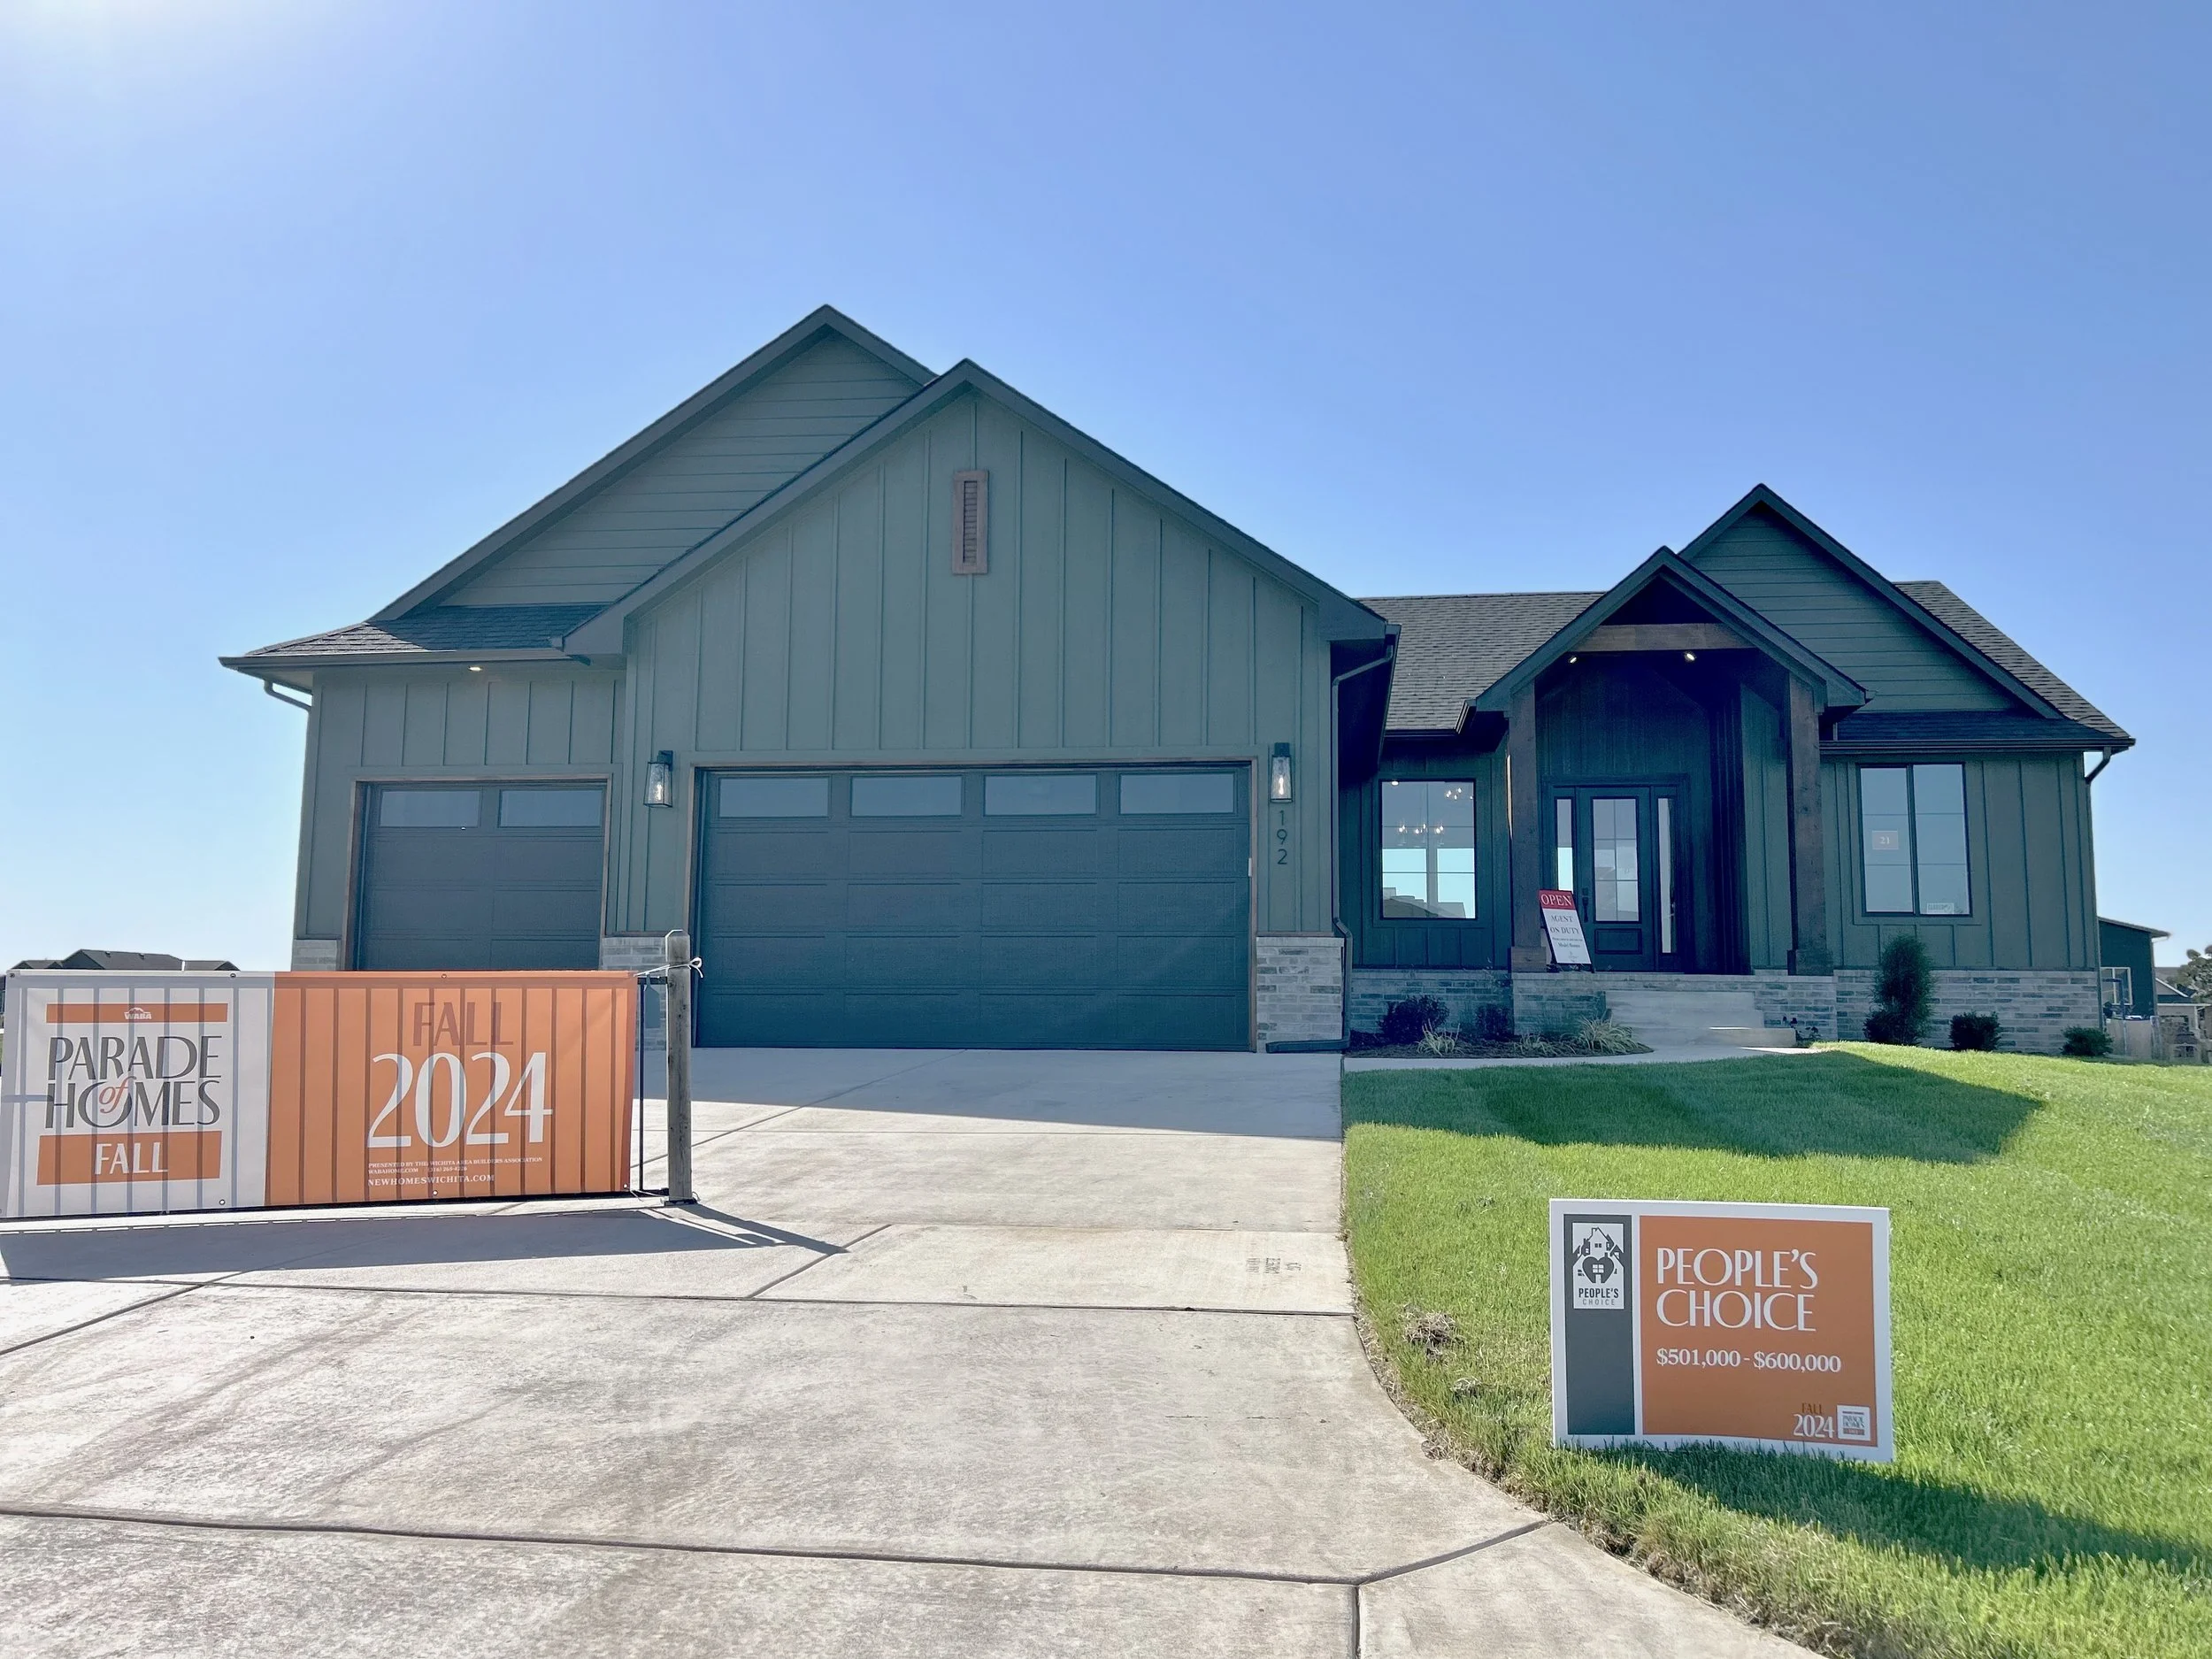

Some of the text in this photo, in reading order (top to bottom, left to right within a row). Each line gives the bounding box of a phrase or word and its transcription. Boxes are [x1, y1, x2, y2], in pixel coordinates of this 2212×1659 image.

[1277, 810, 1287, 864] 192
[1540, 894, 1572, 906] OPEN
[413, 1002, 513, 1046] FALL
[48, 1035, 222, 1080] PARADE
[45, 1079, 220, 1128] HOMES
[98, 1075, 136, 1113] of
[367, 1051, 553, 1148] 2024
[95, 1141, 168, 1174] FALL
[368, 1174, 495, 1187] NEWHOMESWICHITA.COM
[1656, 1248, 1818, 1289] PEOPLE'S
[1578, 1287, 1619, 1298] PEOPLE'S
[1655, 1288, 1816, 1332] CHOICE
[1656, 1348, 1741, 1368] $501,000
[1753, 1351, 1841, 1372] $600,000
[1793, 1413, 1835, 1439] 2024
[1801, 1402, 1823, 1415] FALL
